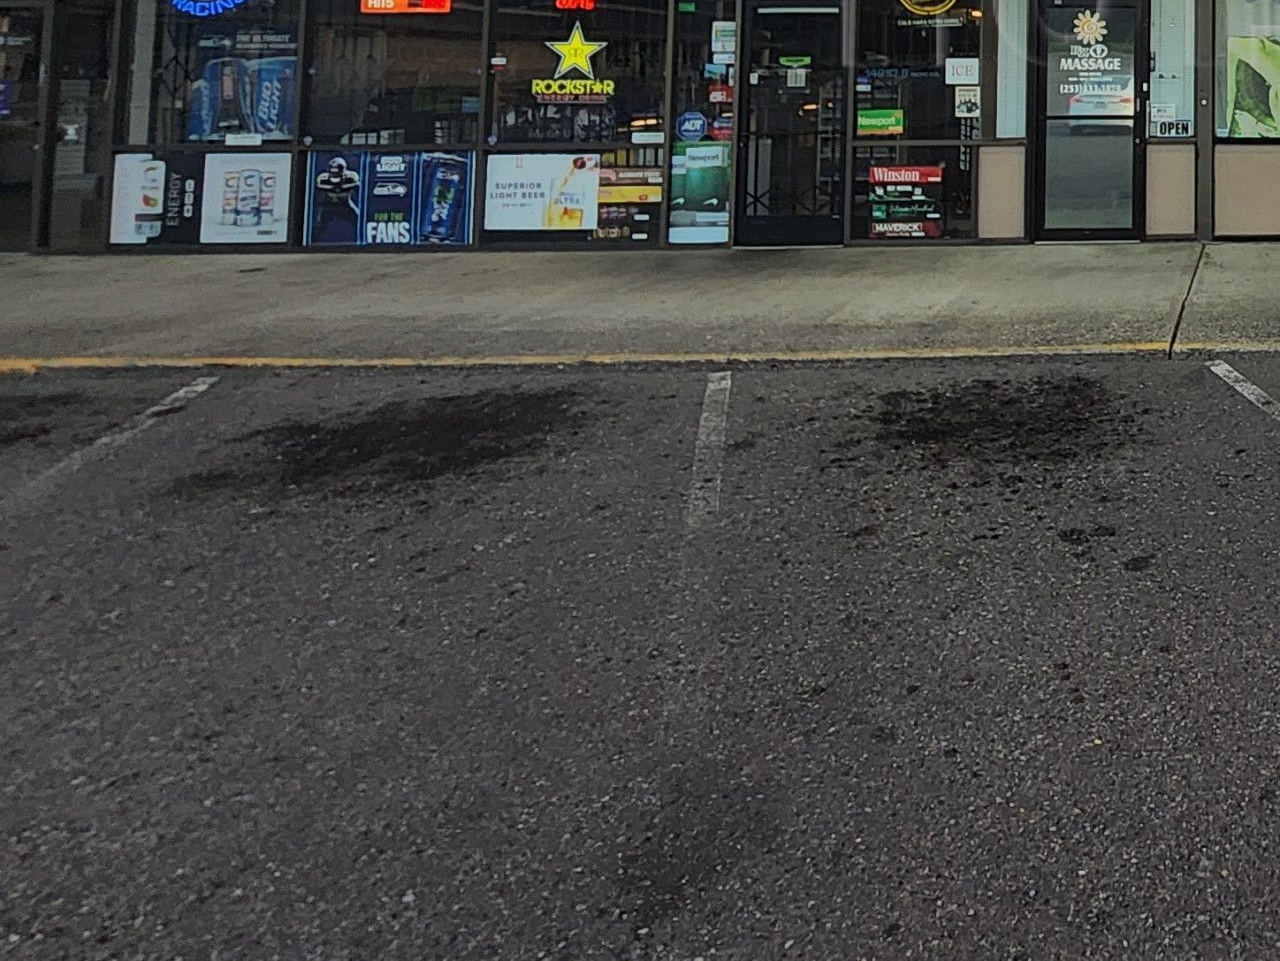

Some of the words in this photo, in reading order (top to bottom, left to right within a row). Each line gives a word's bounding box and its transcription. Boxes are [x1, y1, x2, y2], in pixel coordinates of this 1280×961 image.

[1060, 58, 1121, 70] MASSAGE
[951, 65, 975, 77] ICE
[681, 120, 703, 130] ADT
[858, 116, 895, 127] Newport
[1160, 122, 1189, 135] OPEN
[376, 163, 406, 171] LIGHT
[874, 167, 919, 182] Winston
[495, 182, 542, 190] SUPERIOR
[166, 173, 182, 226] ENERGY
[553, 197, 581, 205] ULTRA
[367, 222, 410, 243] FANS
[874, 223, 920, 232] MAVERICK
